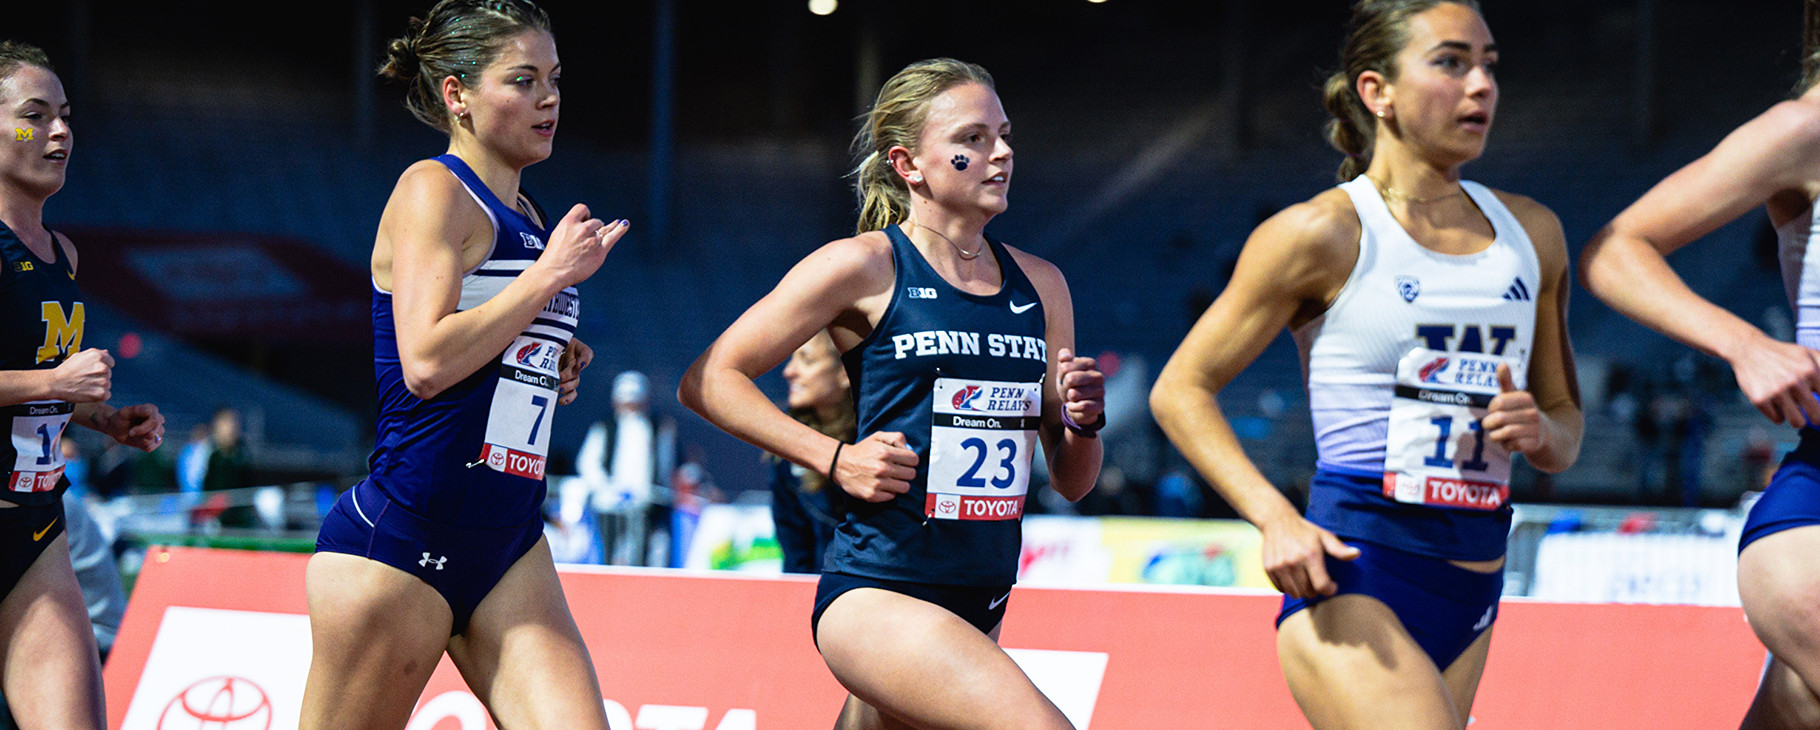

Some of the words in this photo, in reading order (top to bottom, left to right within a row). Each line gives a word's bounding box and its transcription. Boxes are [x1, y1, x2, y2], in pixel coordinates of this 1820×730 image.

[15, 128, 34, 141] M
[36, 301, 86, 365] M
[892, 330, 980, 360] PENN
[514, 370, 539, 385] Dream
[1454, 372, 1500, 387] RELA
[991, 387, 1024, 398] PENN
[987, 400, 1031, 411] RELAYS
[528, 395, 549, 445] 7
[953, 416, 985, 427] Dream
[1423, 415, 1489, 471] 11
[957, 437, 1017, 489] 23
[1428, 481, 1501, 504] TOYOTA
[964, 499, 1018, 516] TOYOTA
